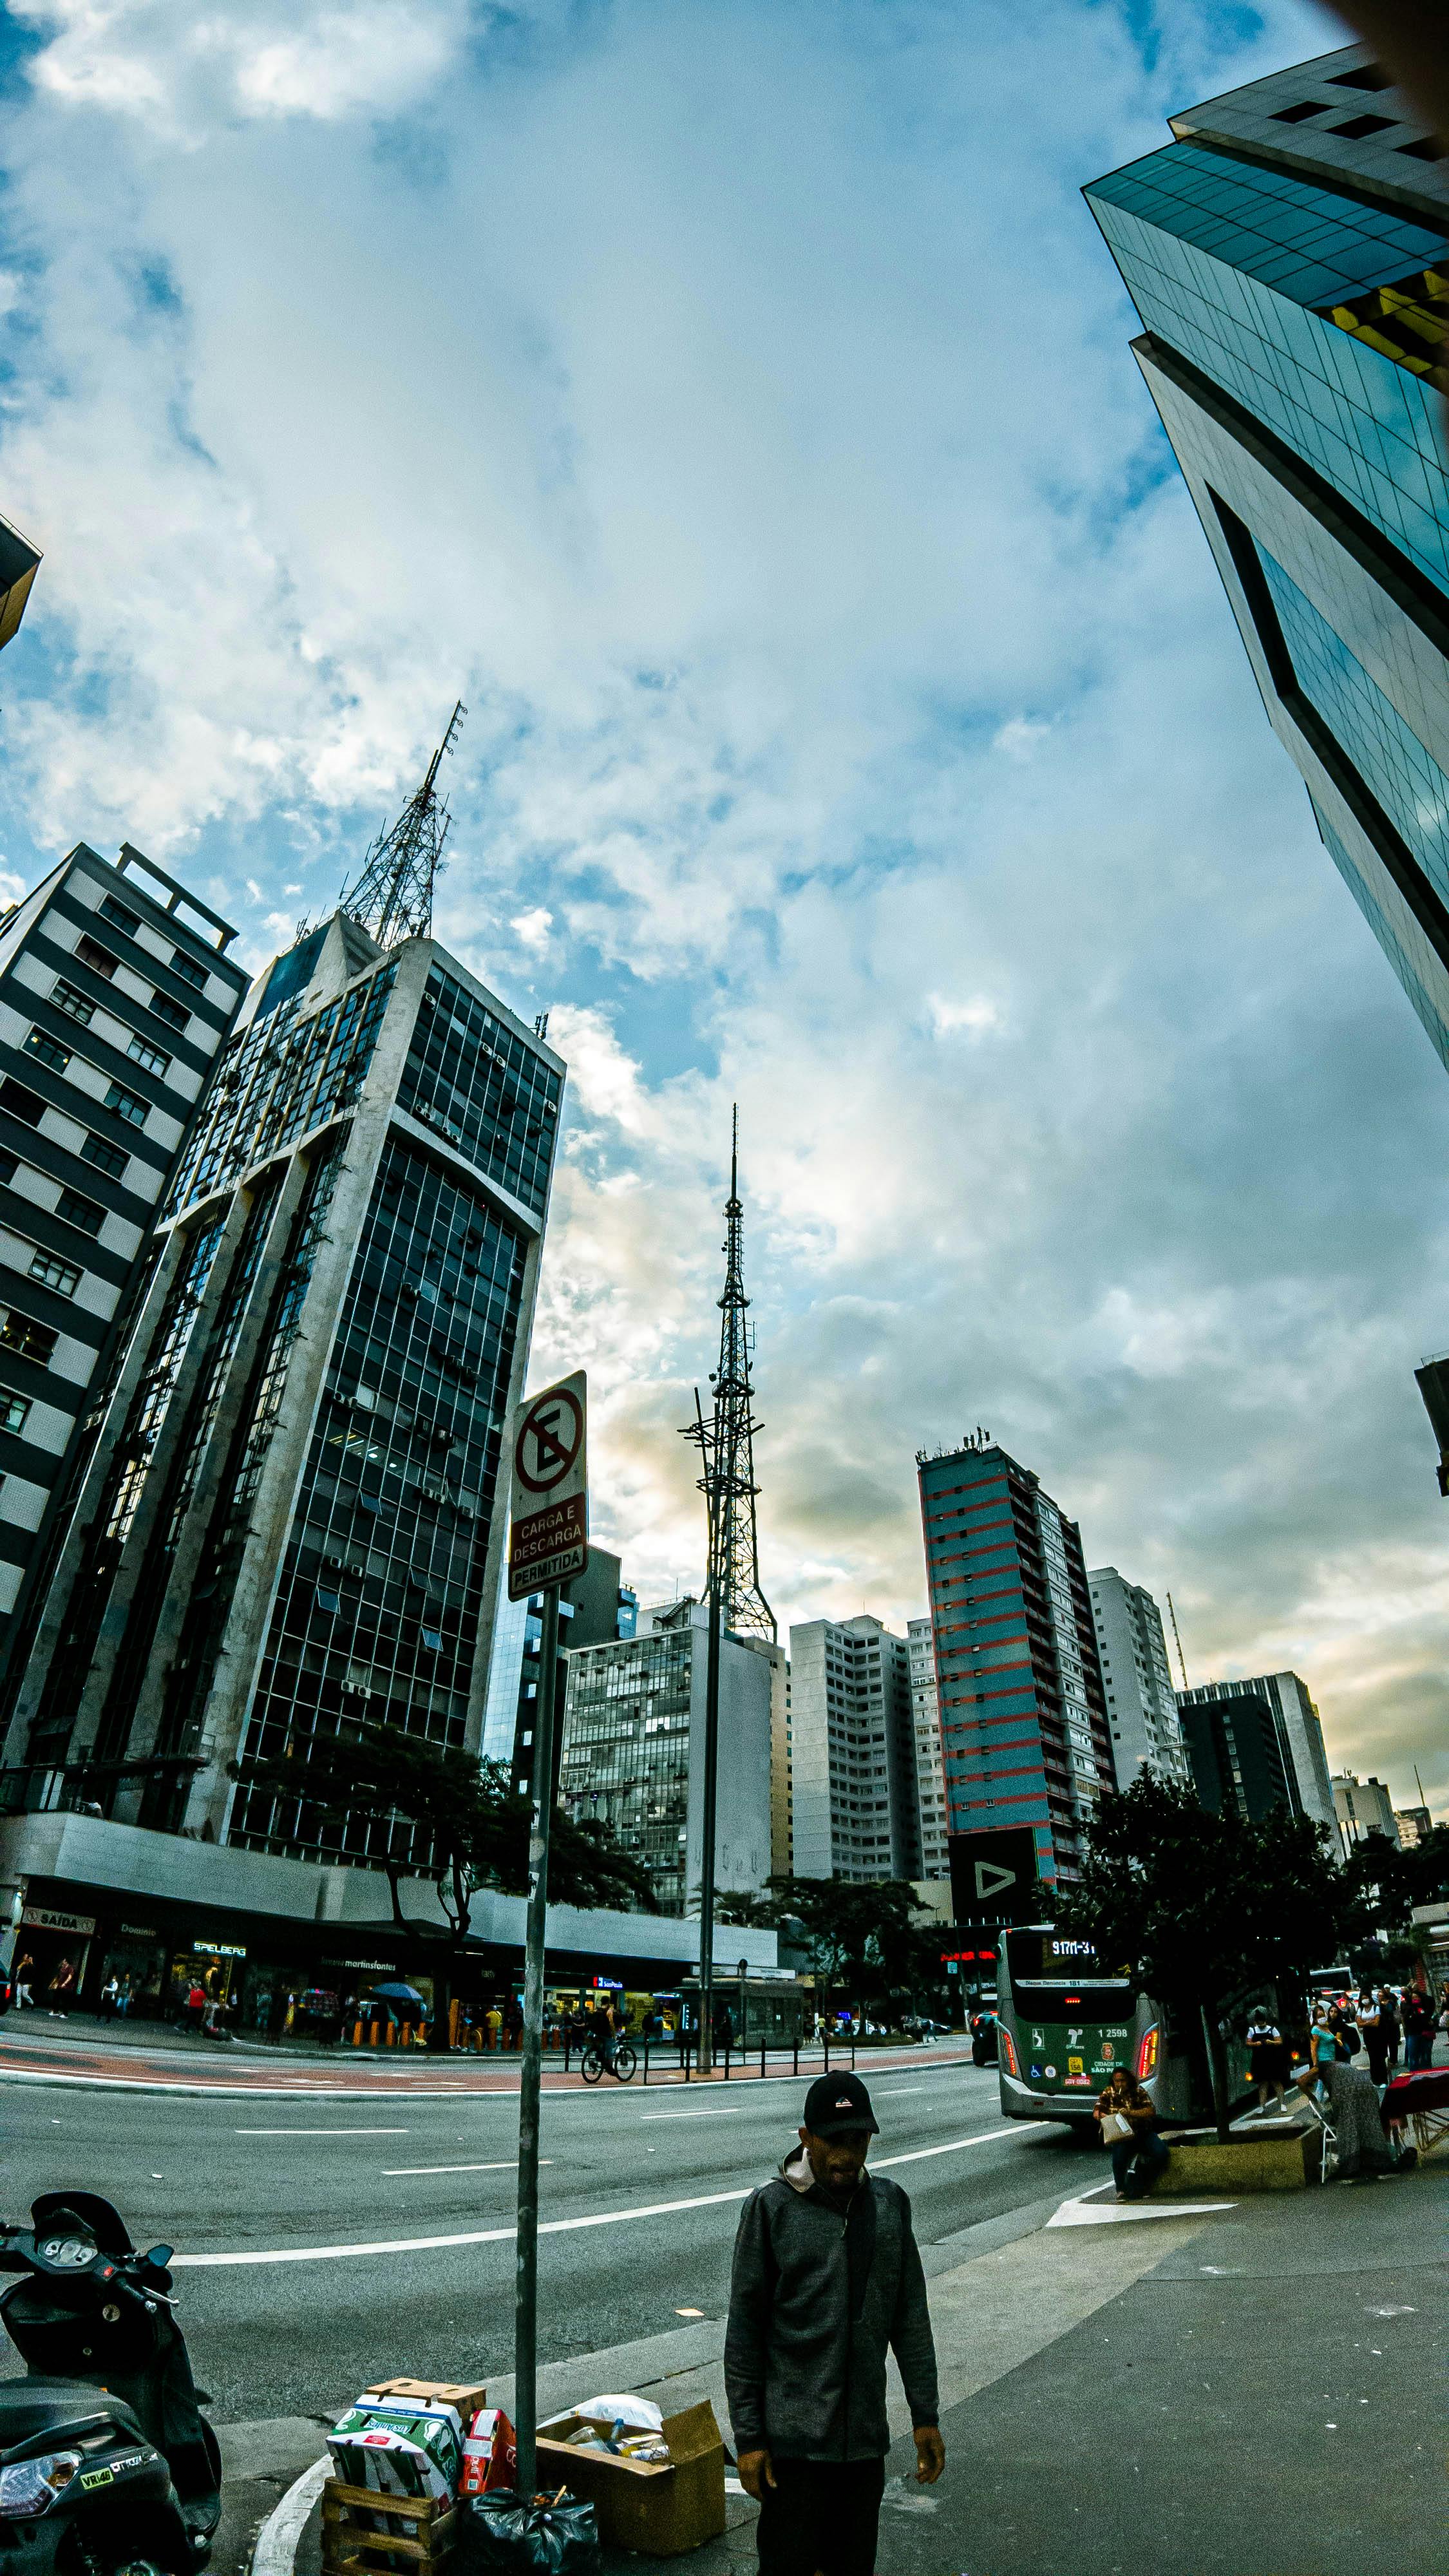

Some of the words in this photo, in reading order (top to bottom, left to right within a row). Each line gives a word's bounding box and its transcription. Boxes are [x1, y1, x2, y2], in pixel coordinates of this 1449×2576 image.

[522, 1511, 564, 1539] CARGA
[567, 1504, 575, 1520] E
[514, 1524, 582, 1562] DESCARGA
[515, 1550, 580, 1587] PERMITIDA
[194, 1942, 246, 1956] SPIELBERG
[1098, 2029, 1103, 2038] 1
[1106, 2029, 1128, 2038] 2598
